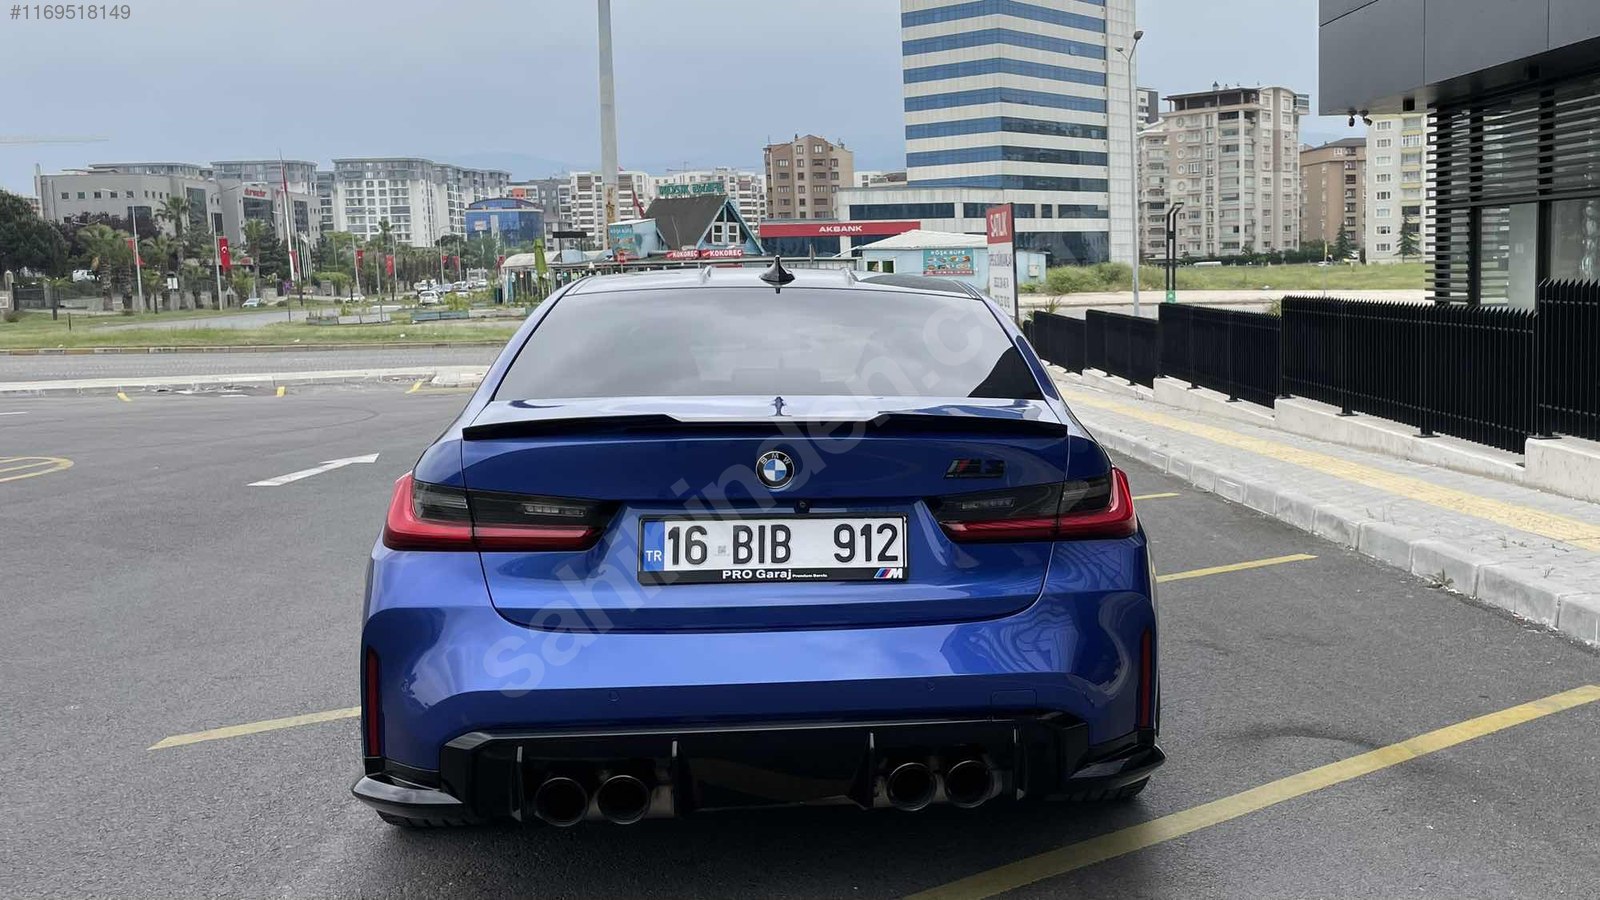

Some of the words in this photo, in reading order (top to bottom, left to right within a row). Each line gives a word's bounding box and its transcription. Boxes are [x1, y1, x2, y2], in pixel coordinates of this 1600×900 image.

[819, 225, 863, 233] AKBANK
[672, 250, 699, 258] KOKOREÇ
[709, 249, 742, 257] KOKOREÇ
[760, 453, 791, 464] BMW
[668, 525, 708, 566] 16
[732, 524, 792, 565] BIB
[833, 523, 899, 562] 912
[645, 550, 662, 562] TR
[722, 570, 753, 579] PRO
[755, 569, 791, 580] Garaj
